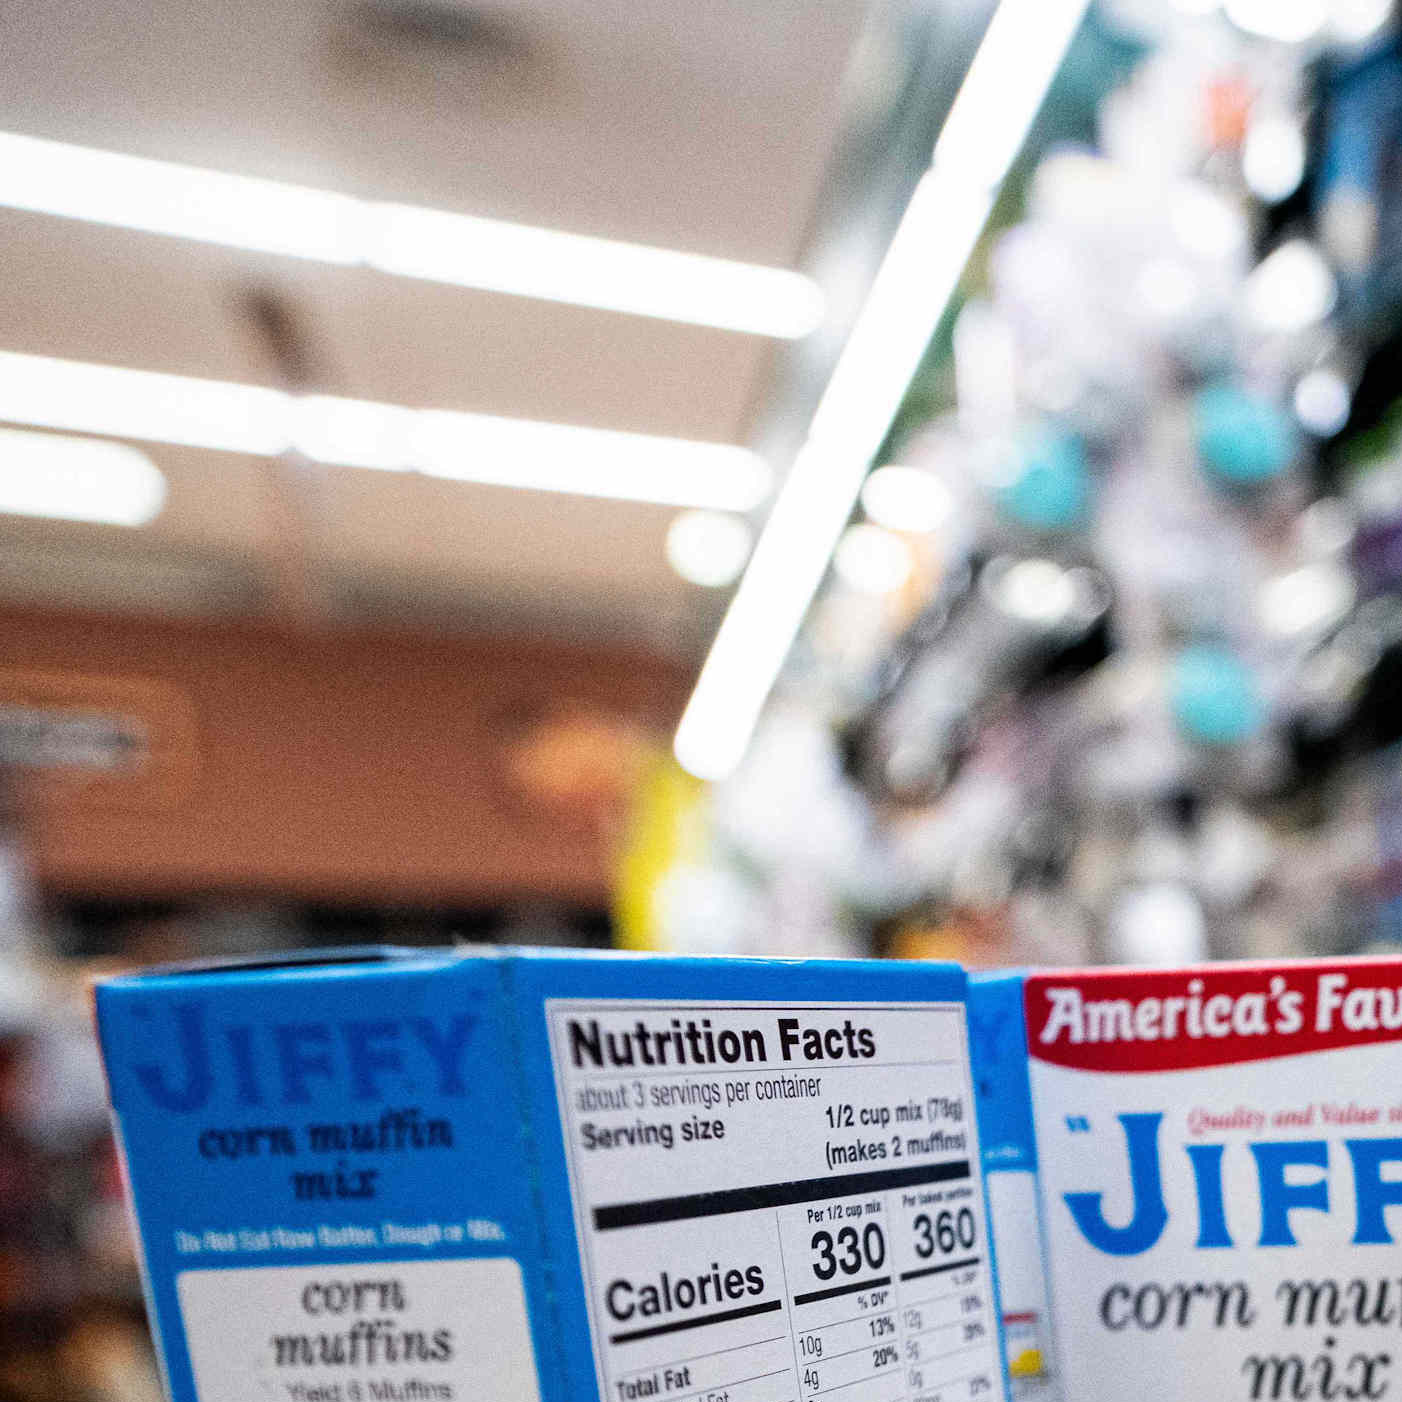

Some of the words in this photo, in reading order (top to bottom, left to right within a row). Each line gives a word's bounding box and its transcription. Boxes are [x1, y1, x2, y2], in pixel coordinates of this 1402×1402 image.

[1037, 976, 1302, 1047] America's
[567, 1017, 768, 1068] Nutrition
[777, 1017, 877, 1062] Facts
[575, 1083, 628, 1113] about
[632, 1081, 645, 1106] 3
[650, 1078, 721, 1110] servings
[725, 1078, 751, 1104] per
[755, 1073, 822, 1101] container
[199, 1126, 296, 1160] corn
[309, 1107, 454, 1154] muffin
[580, 1122, 674, 1152] Serving
[681, 1118, 726, 1141] size
[825, 1104, 855, 1130] 1/2
[860, 1106, 890, 1128] cup
[895, 1101, 923, 1122] mix
[825, 1141, 888, 1171] (makes
[891, 1138, 903, 1158] 2
[907, 1132, 967, 1158] muffins)
[291, 1162, 379, 1200] mix
[807, 1209, 825, 1224] Per
[827, 1205, 844, 1220] 1/2
[845, 1203, 863, 1219] cup
[864, 1201, 881, 1215] mix
[605, 1262, 766, 1323] Calories
[809, 1221, 886, 1281] 330
[912, 1207, 976, 1260] 360
[301, 1278, 405, 1315] corn
[1098, 1274, 1255, 1332] corn
[272, 1320, 453, 1366] muffins
[615, 1374, 659, 1402] Total
[664, 1366, 692, 1392] Fat
[799, 1336, 823, 1358] 10g
[803, 1368, 819, 1390] 4g
